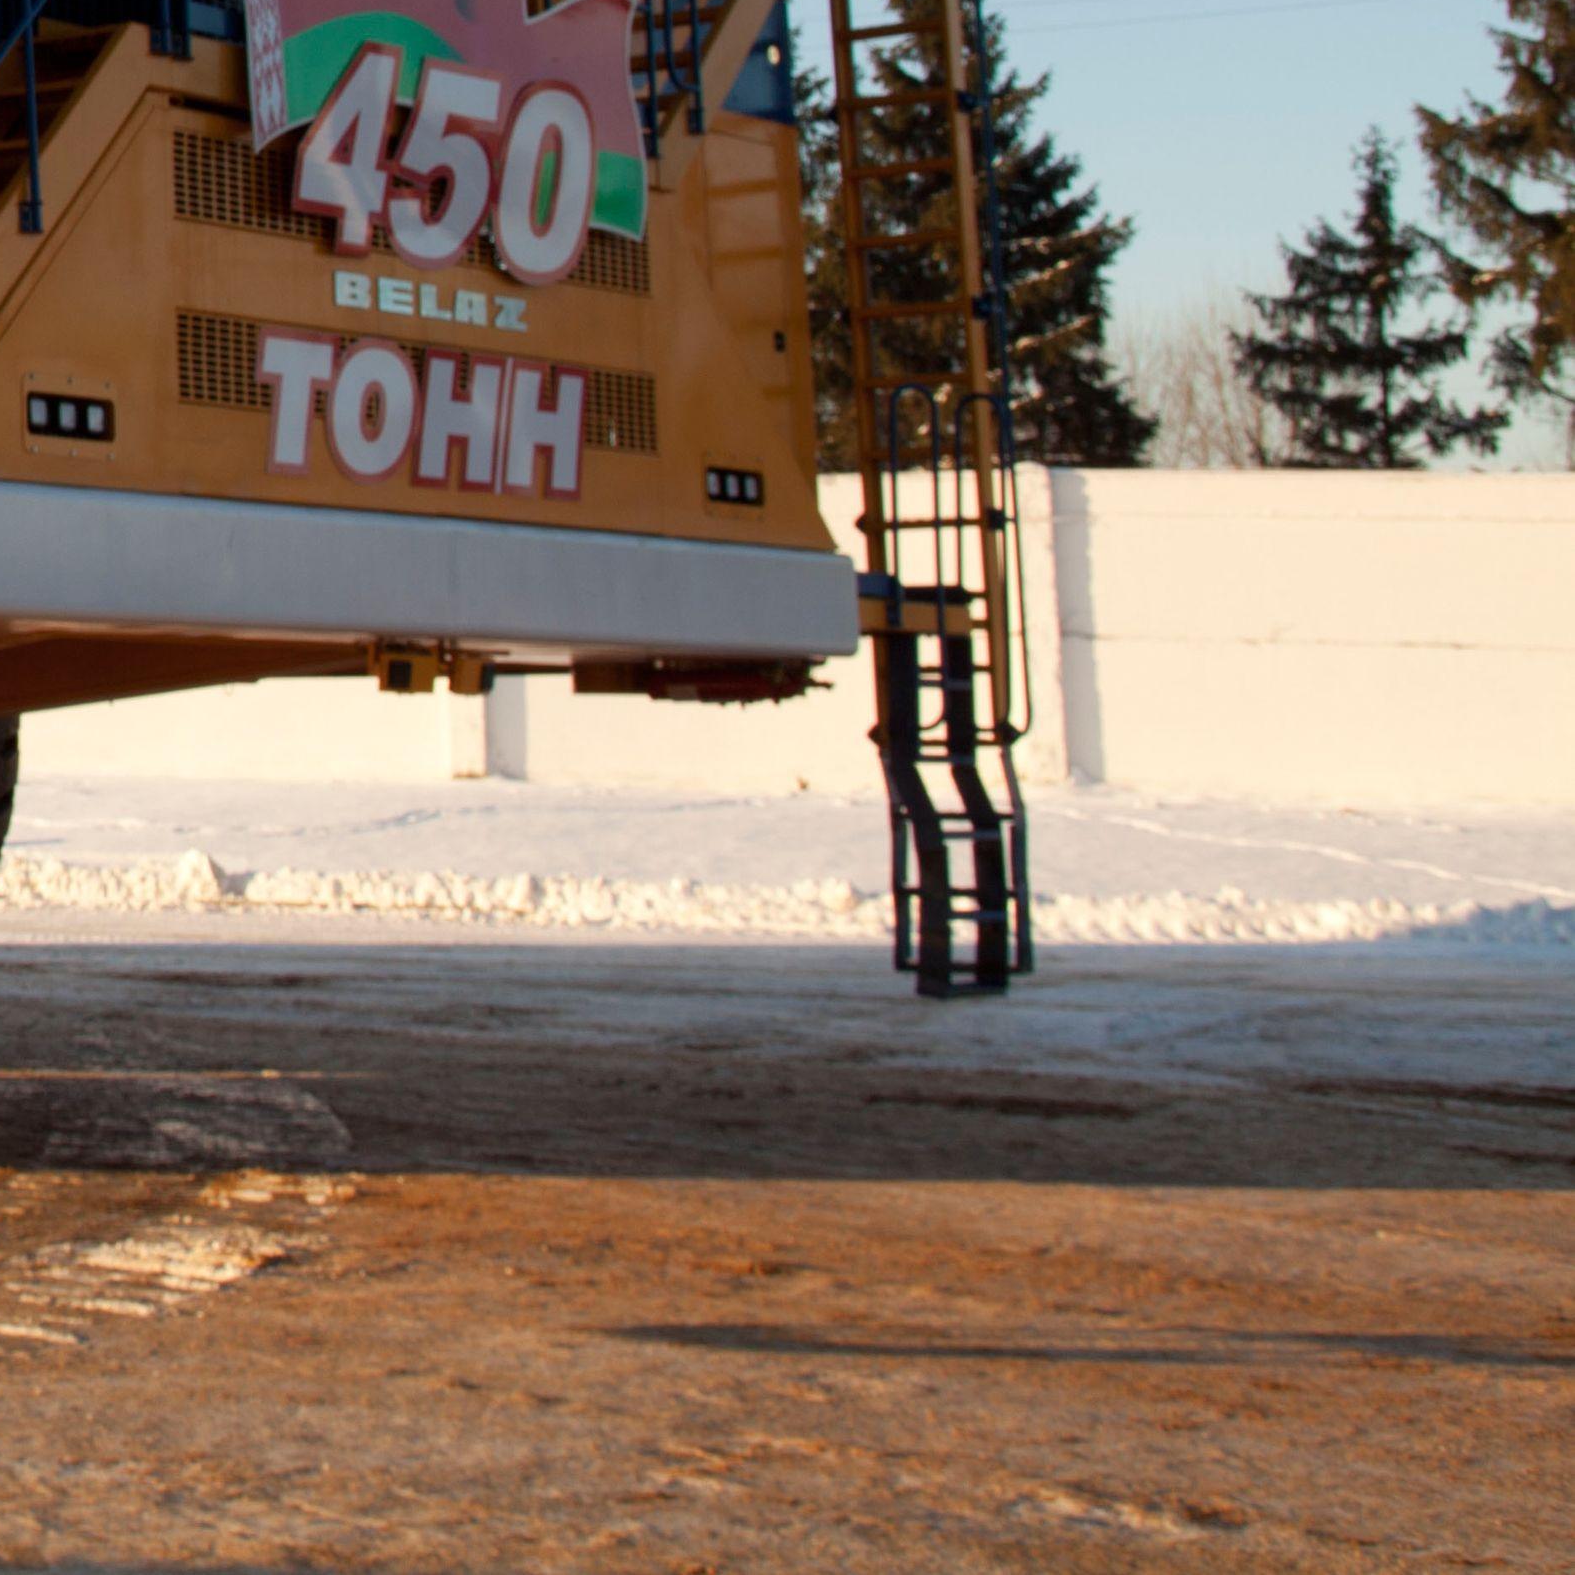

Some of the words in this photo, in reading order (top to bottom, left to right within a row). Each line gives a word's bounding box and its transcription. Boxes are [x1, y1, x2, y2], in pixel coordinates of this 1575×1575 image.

[293, 42, 594, 286] 450
[334, 271, 528, 332] BELAZ
[257, 329, 589, 501] ТОНН
